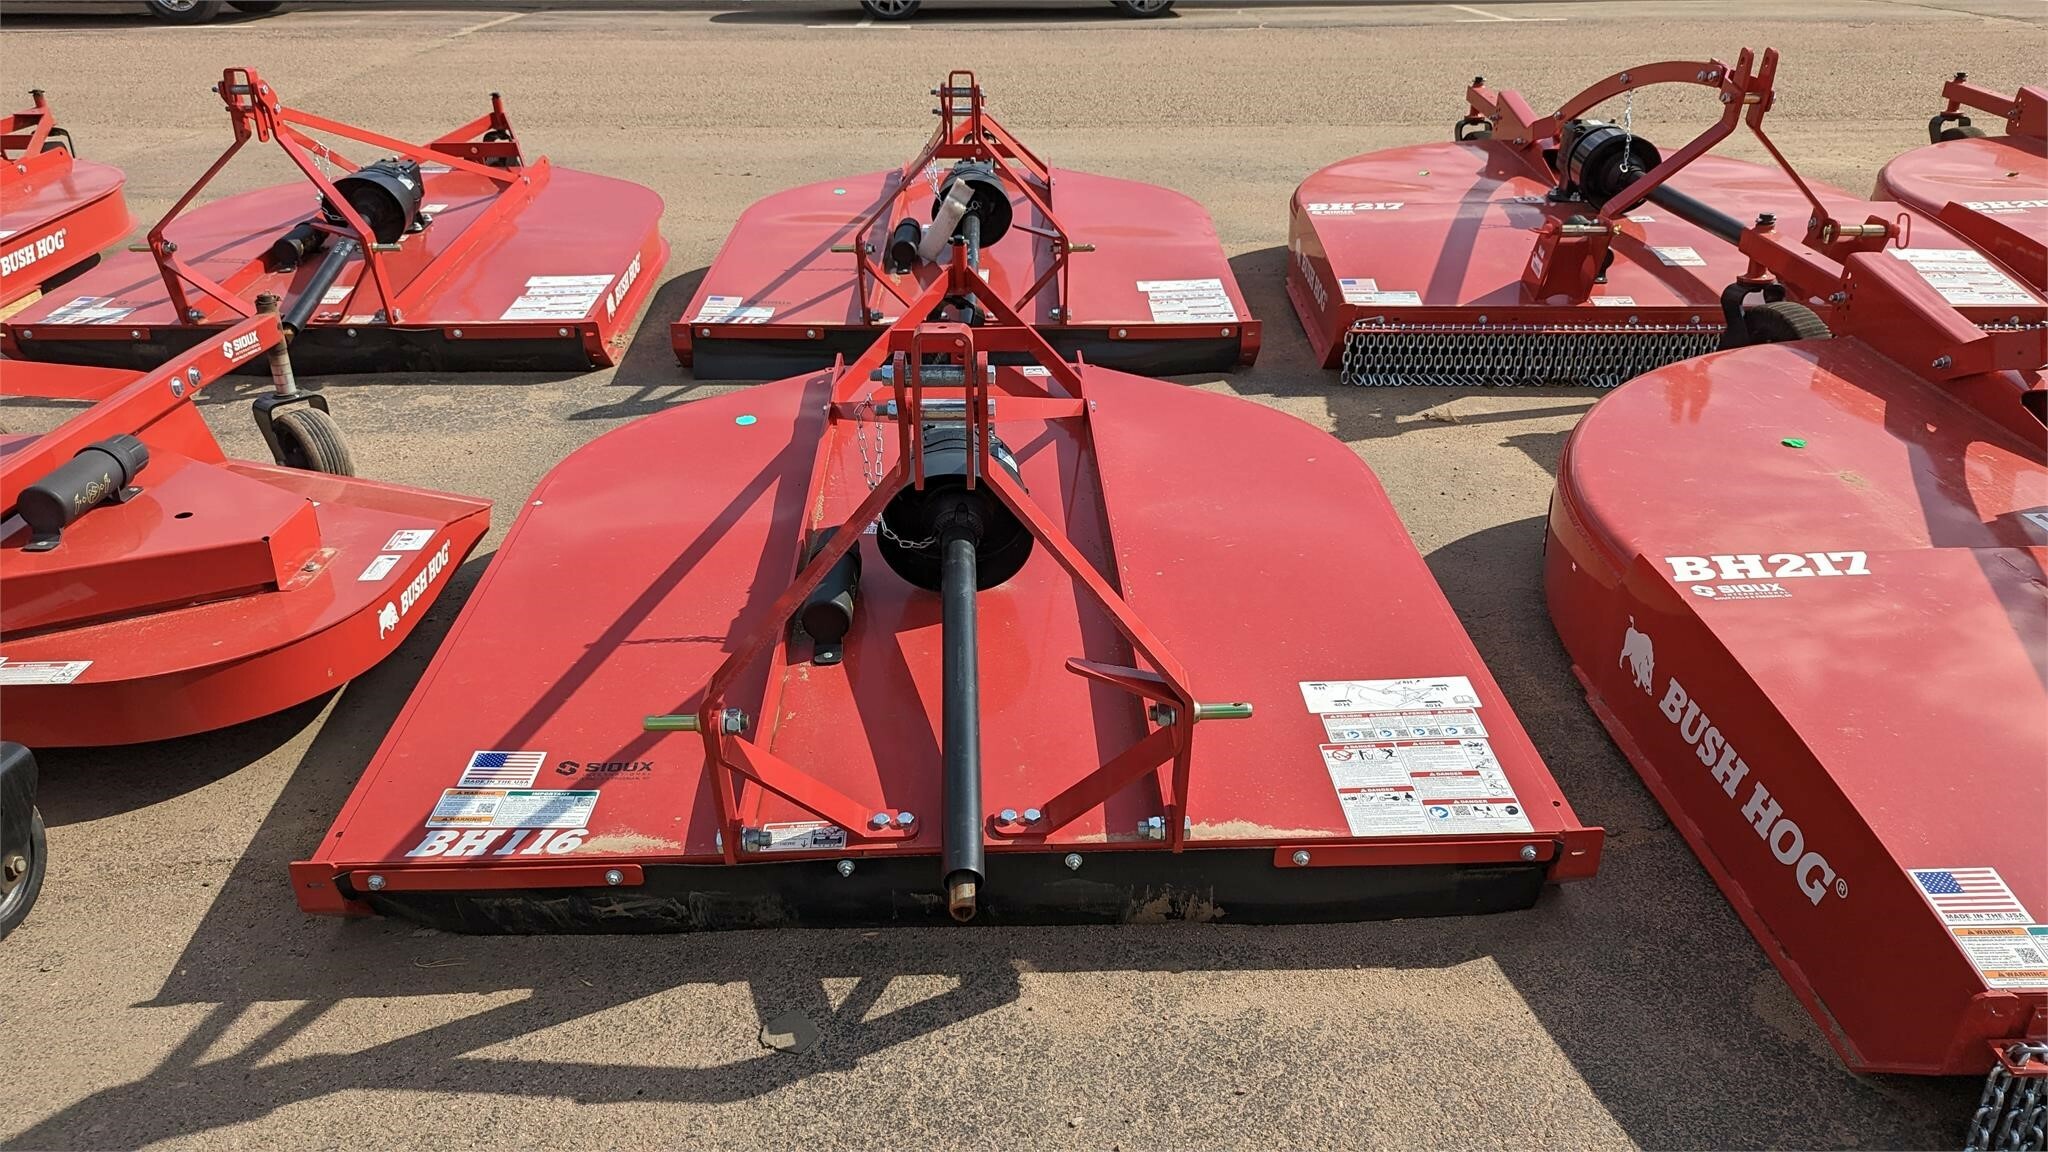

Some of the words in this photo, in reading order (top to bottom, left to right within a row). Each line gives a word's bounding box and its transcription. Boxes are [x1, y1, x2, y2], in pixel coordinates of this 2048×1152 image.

[1306, 202, 1404, 211] BH217
[0, 243, 36, 277] BUSH
[232, 330, 259, 351] SIOUX
[1665, 551, 1872, 583] BH217
[400, 566, 428, 617] BUSH
[1716, 583, 1786, 594] SIOUX
[1658, 676, 1750, 800] BUSH
[585, 761, 654, 772] SIOUX
[405, 828, 589, 857] BH116
